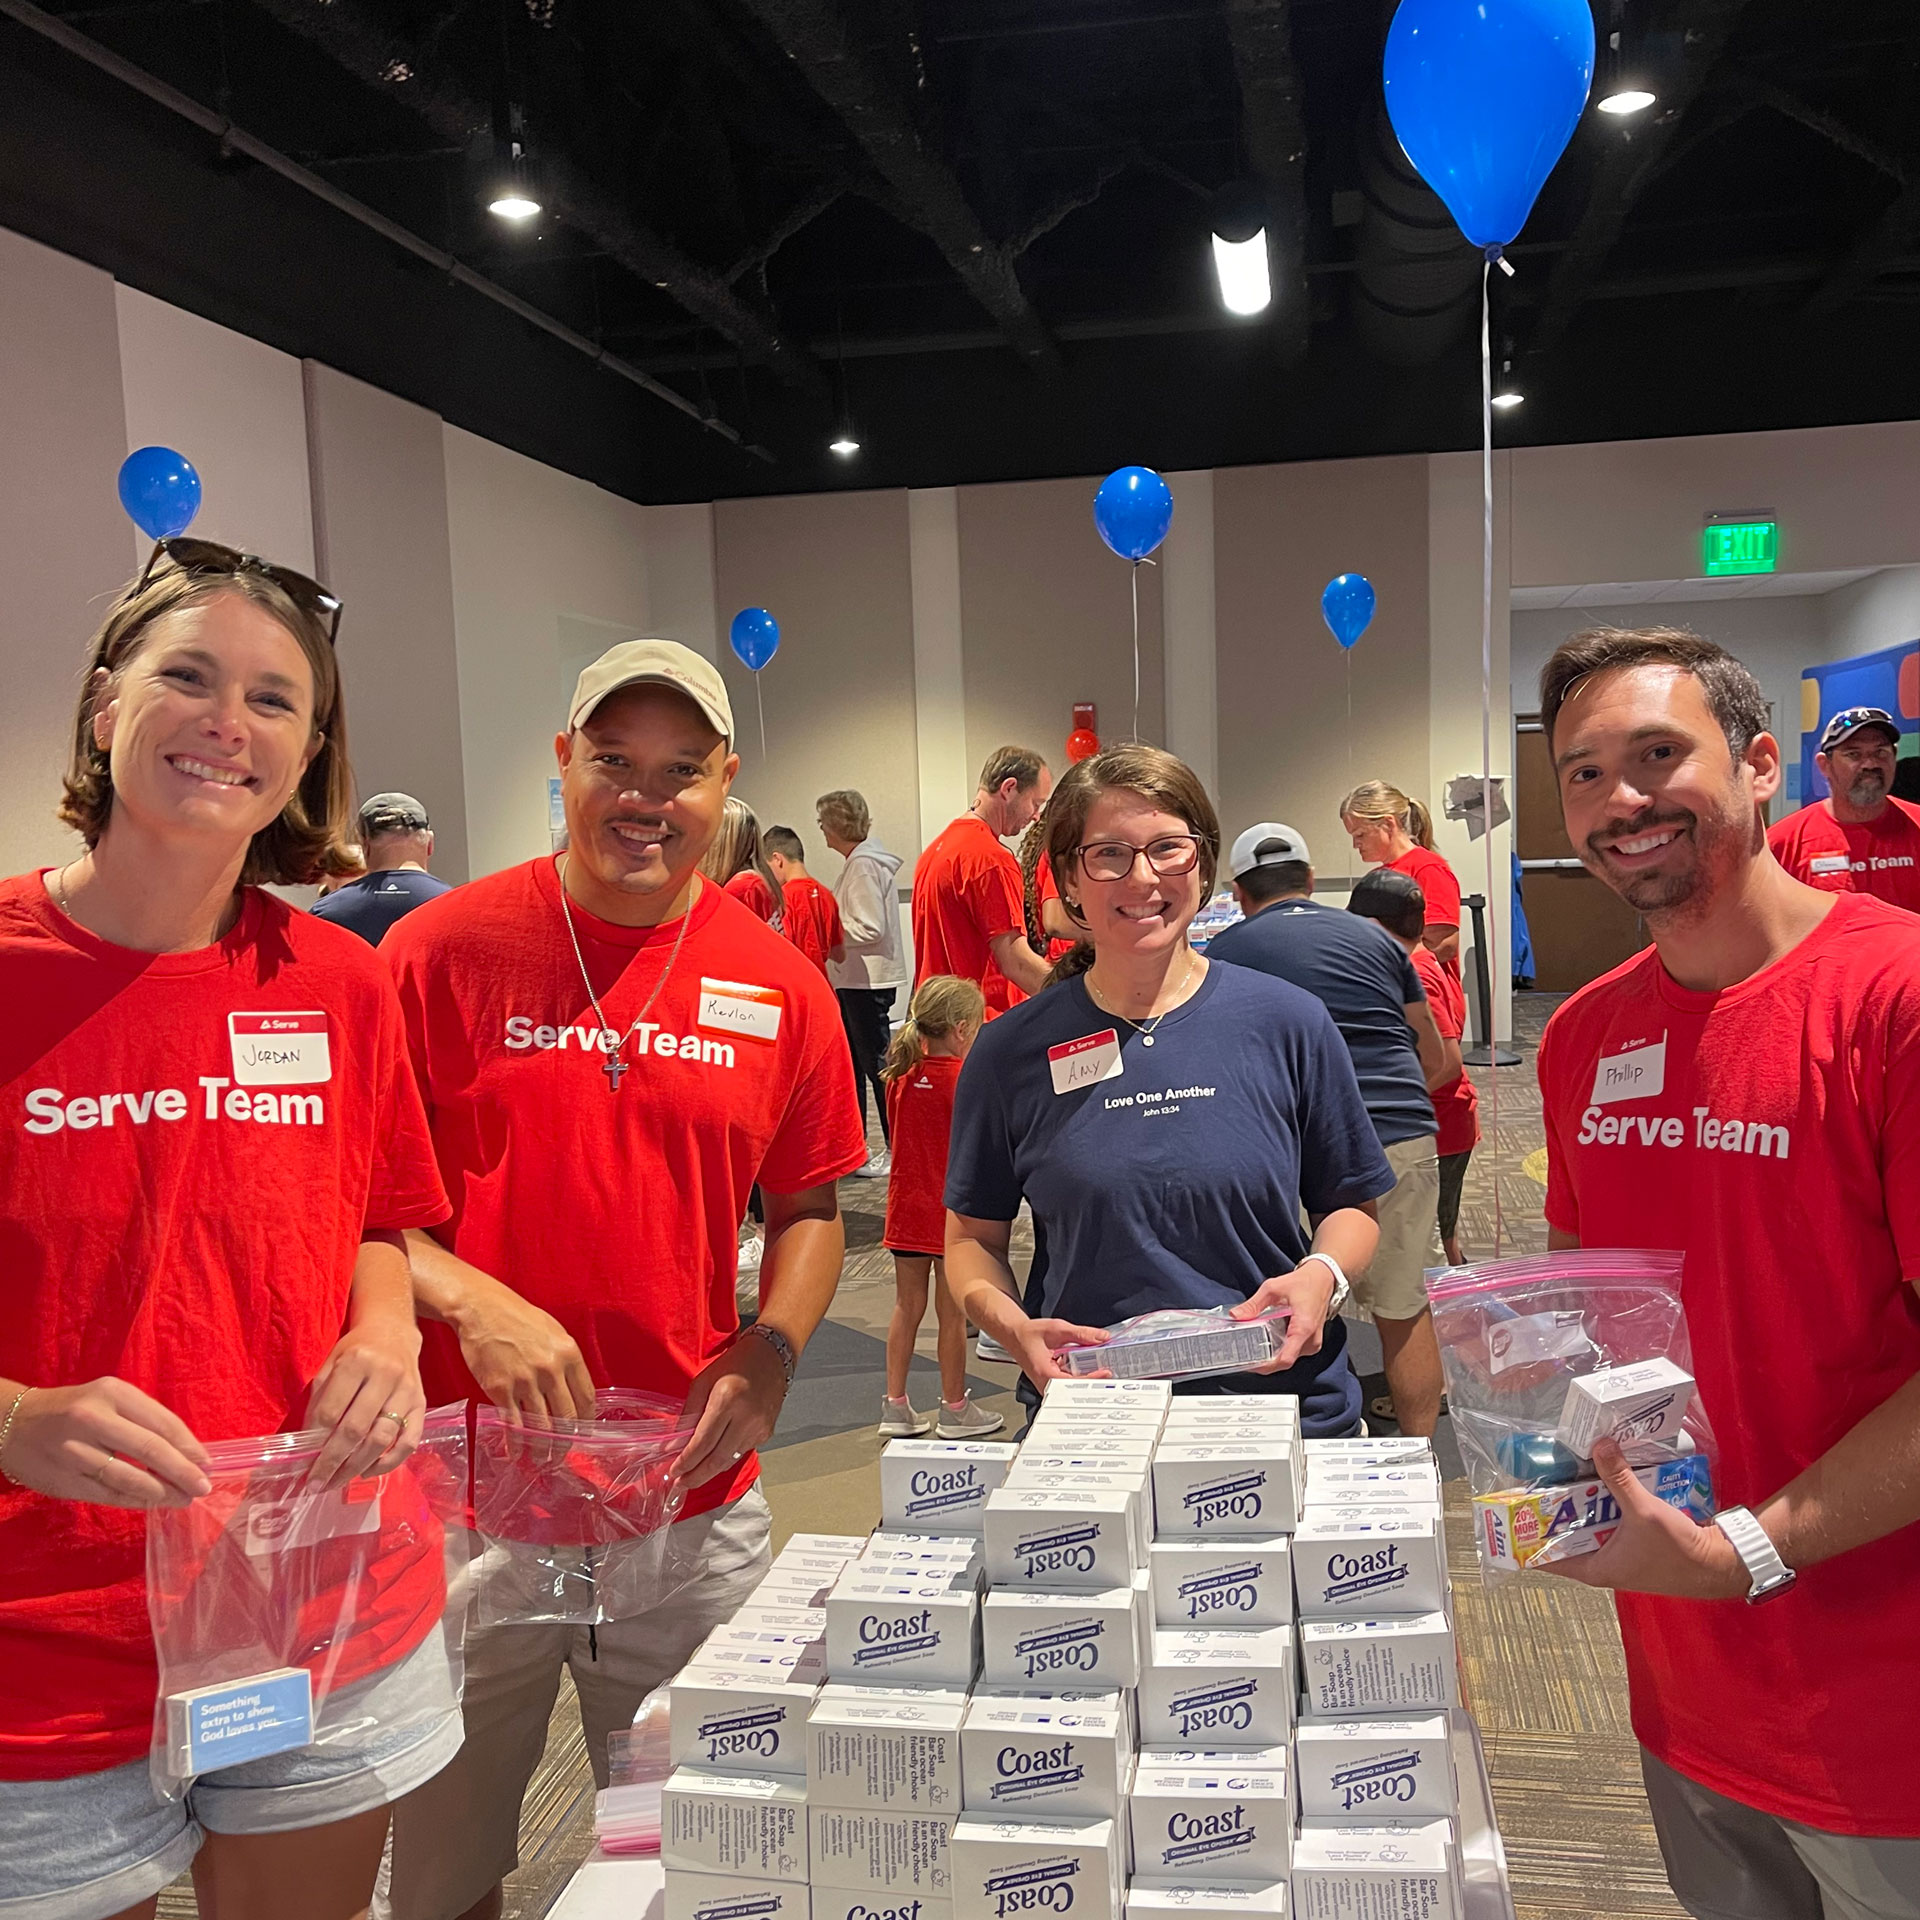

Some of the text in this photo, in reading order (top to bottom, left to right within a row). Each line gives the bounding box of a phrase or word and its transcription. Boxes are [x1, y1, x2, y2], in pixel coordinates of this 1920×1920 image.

[1719, 527, 1768, 560] EXIT
[1868, 856, 1914, 871] Team
[271, 1019, 299, 1030] Serve
[503, 1016, 736, 1068] Serve Team
[23, 1076, 324, 1135] Serve Team
[1104, 1085, 1216, 1109] Love One Another
[1143, 1107, 1160, 1117] John
[1577, 1106, 1790, 1159] Serve Team
[911, 1464, 977, 1497] Coast
[1193, 1492, 1262, 1528] Coast
[1515, 1507, 1536, 1523] 20%
[1540, 1484, 1622, 1539] Aim
[1492, 1509, 1507, 1558] Aim
[1514, 1521, 1539, 1536] MORE
[1024, 1545, 1096, 1579] Coast
[1327, 1543, 1398, 1581] Coast
[1187, 1584, 1258, 1619] Coast
[859, 1609, 932, 1644] Coast
[1024, 1642, 1099, 1679] Coast
[1336, 1664, 1344, 1688] ocean
[1328, 1672, 1338, 1708] Bar Soap
[1343, 1649, 1356, 1707] friendly choice
[201, 1694, 261, 1716] Something
[1320, 1685, 1329, 1709] Coast
[1339, 1690, 1346, 1699] an
[201, 1705, 275, 1730] extra to show
[201, 1730, 224, 1743] God
[226, 1723, 255, 1737] loves
[1178, 1701, 1253, 1738] Coast
[706, 1728, 780, 1762] Coast
[909, 1736, 918, 1770] friendly
[920, 1745, 926, 1756] an
[997, 1741, 1075, 1777] Coast
[928, 1754, 937, 1777] Soap
[1341, 1773, 1417, 1810] Coast
[760, 1806, 768, 1838] friendly
[770, 1816, 776, 1826] an
[778, 1825, 786, 1847] Soap
[787, 1809, 795, 1834] Coast
[911, 1821, 919, 1853] friendly
[921, 1830, 928, 1840] an
[1168, 1804, 1246, 1842] Coast
[930, 1822, 938, 1861] Bar Soap
[994, 1882, 1074, 1919] Coast
[1400, 1879, 1409, 1911] friendly
[1411, 1888, 1419, 1898] an
[1420, 1879, 1430, 1918] Bar Soap
[1429, 1879, 1439, 1905] Coast
[1412, 1900, 1420, 1920] ocea
